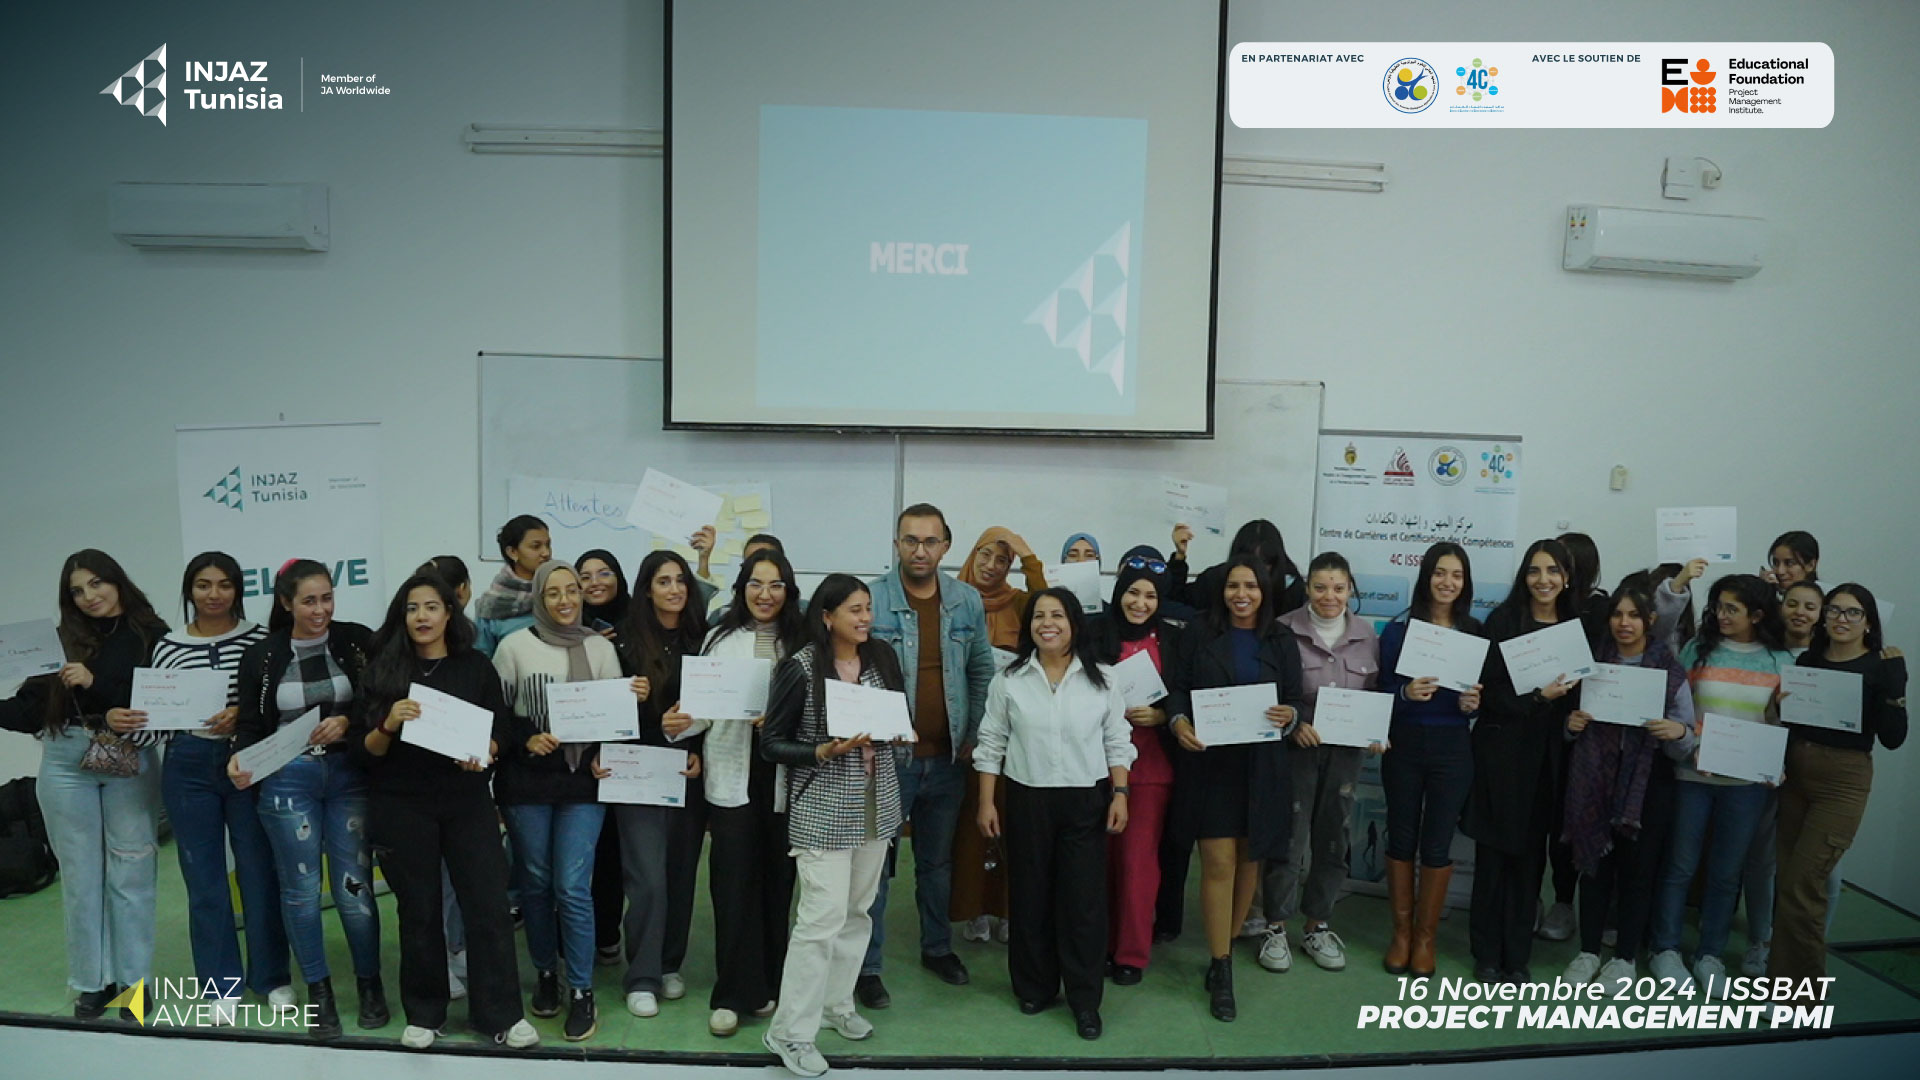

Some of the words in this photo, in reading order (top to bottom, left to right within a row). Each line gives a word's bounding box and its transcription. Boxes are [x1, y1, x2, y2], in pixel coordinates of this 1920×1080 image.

[869, 241, 969, 275] MERCI
[1488, 453, 1505, 474] 4C
[251, 472, 298, 487] INJAZ
[252, 487, 308, 503] Tunisia
[1319, 527, 1342, 538] Centre
[1343, 528, 1353, 539] de
[1354, 529, 1388, 541] Carrières
[1389, 532, 1398, 541] et
[1461, 536, 1514, 549] Compétences
[1389, 553, 1402, 566] 4C
